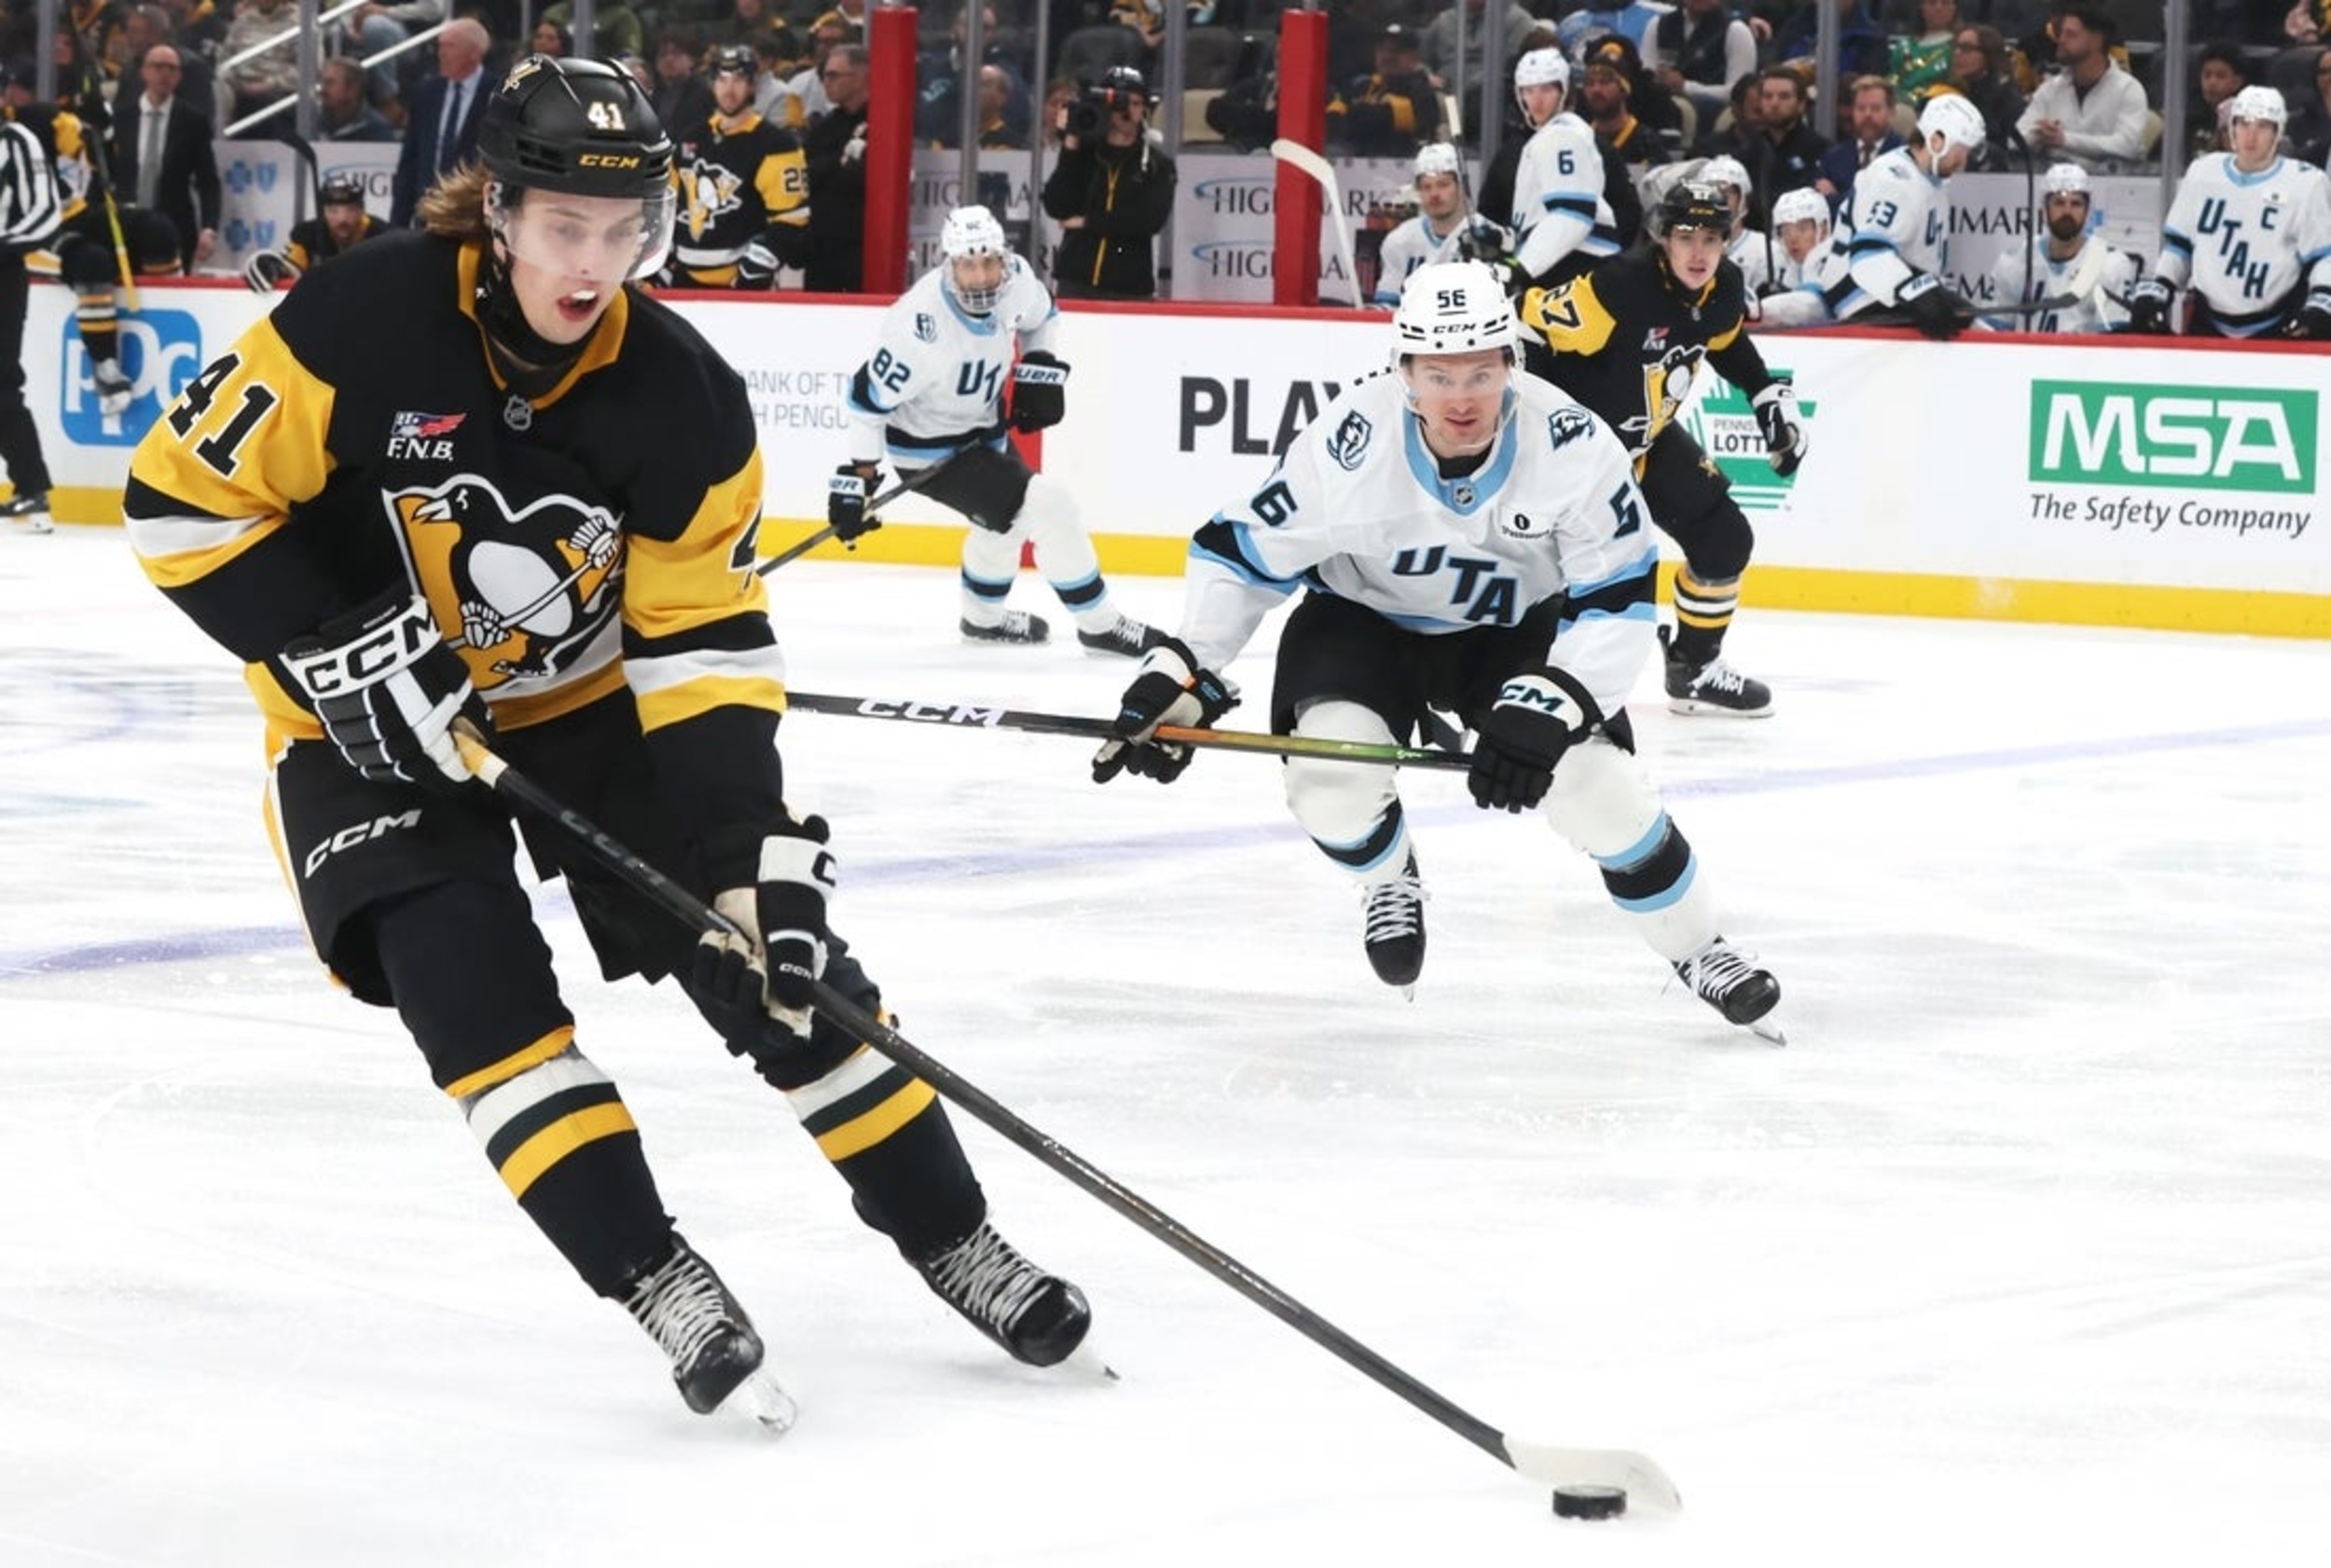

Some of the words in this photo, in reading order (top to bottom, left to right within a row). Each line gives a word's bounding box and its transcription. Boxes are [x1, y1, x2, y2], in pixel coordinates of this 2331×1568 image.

[586, 101, 626, 131] 41
[579, 153, 641, 169] CCM
[1558, 149, 1576, 175] 6
[2260, 206, 2279, 230] C
[2196, 197, 2269, 299] UTAH
[1433, 323, 1477, 335] CCM
[797, 372, 827, 395] OF
[872, 347, 911, 393] 82
[168, 352, 277, 477] 41
[2042, 392, 2302, 481] MSA
[2031, 493, 2076, 519] The
[2084, 496, 2171, 532] Safety
[2178, 501, 2311, 540] Company
[855, 697, 1005, 729] CCM
[304, 808, 422, 879] CCM
